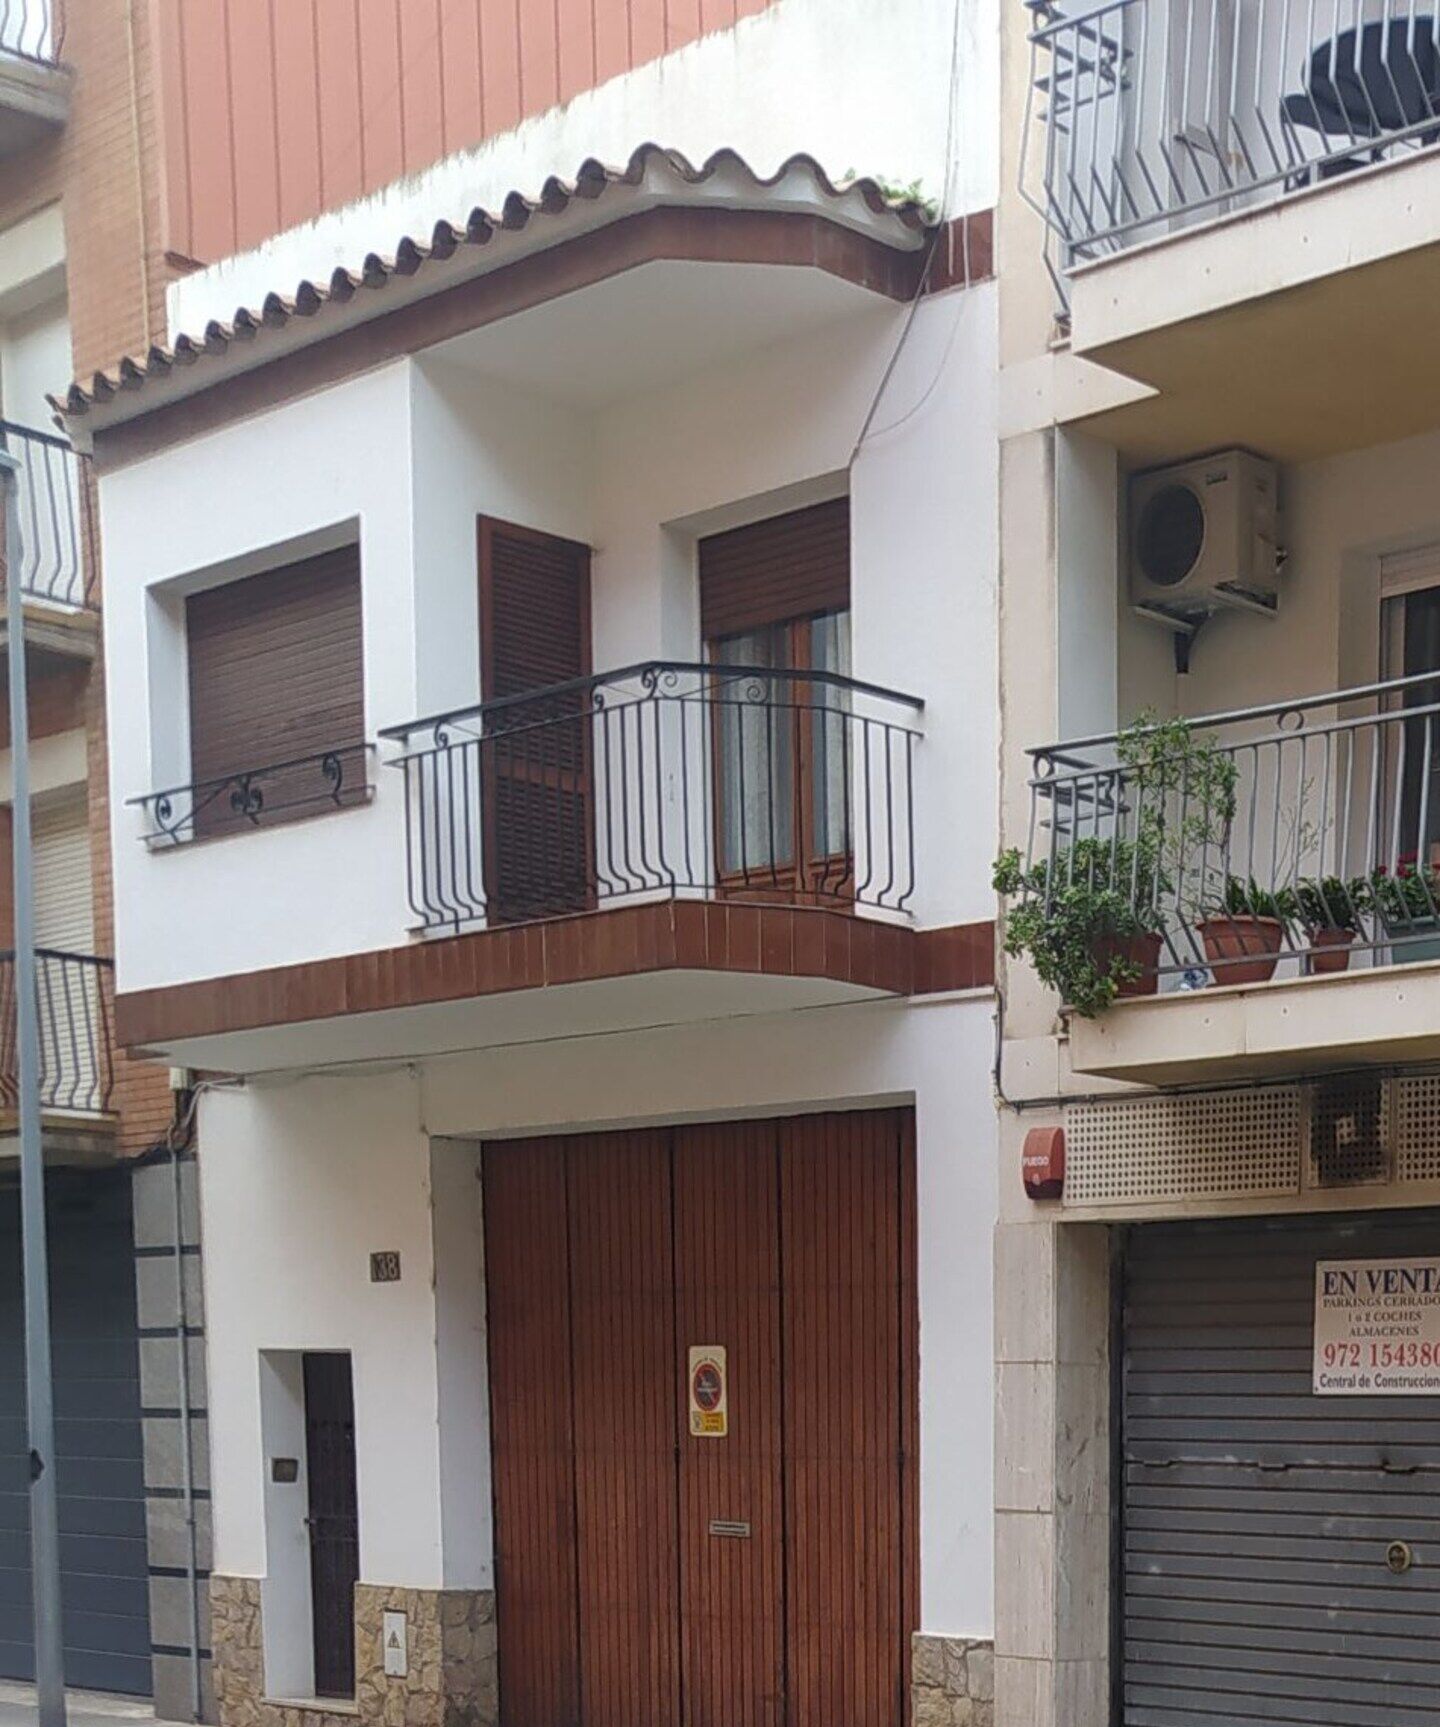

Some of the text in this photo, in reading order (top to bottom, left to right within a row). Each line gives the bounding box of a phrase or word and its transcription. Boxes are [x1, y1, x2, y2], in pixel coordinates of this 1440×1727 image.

[1323, 1271, 1357, 1295] EN
[1323, 1297, 1382, 1308] PARKINGS
[1374, 1311, 1422, 1322] COCHES
[1349, 1326, 1420, 1337] ALMACENES
[1324, 1343, 1361, 1367] 972
[1319, 1373, 1356, 1388] Central
[1358, 1374, 1371, 1388] de
